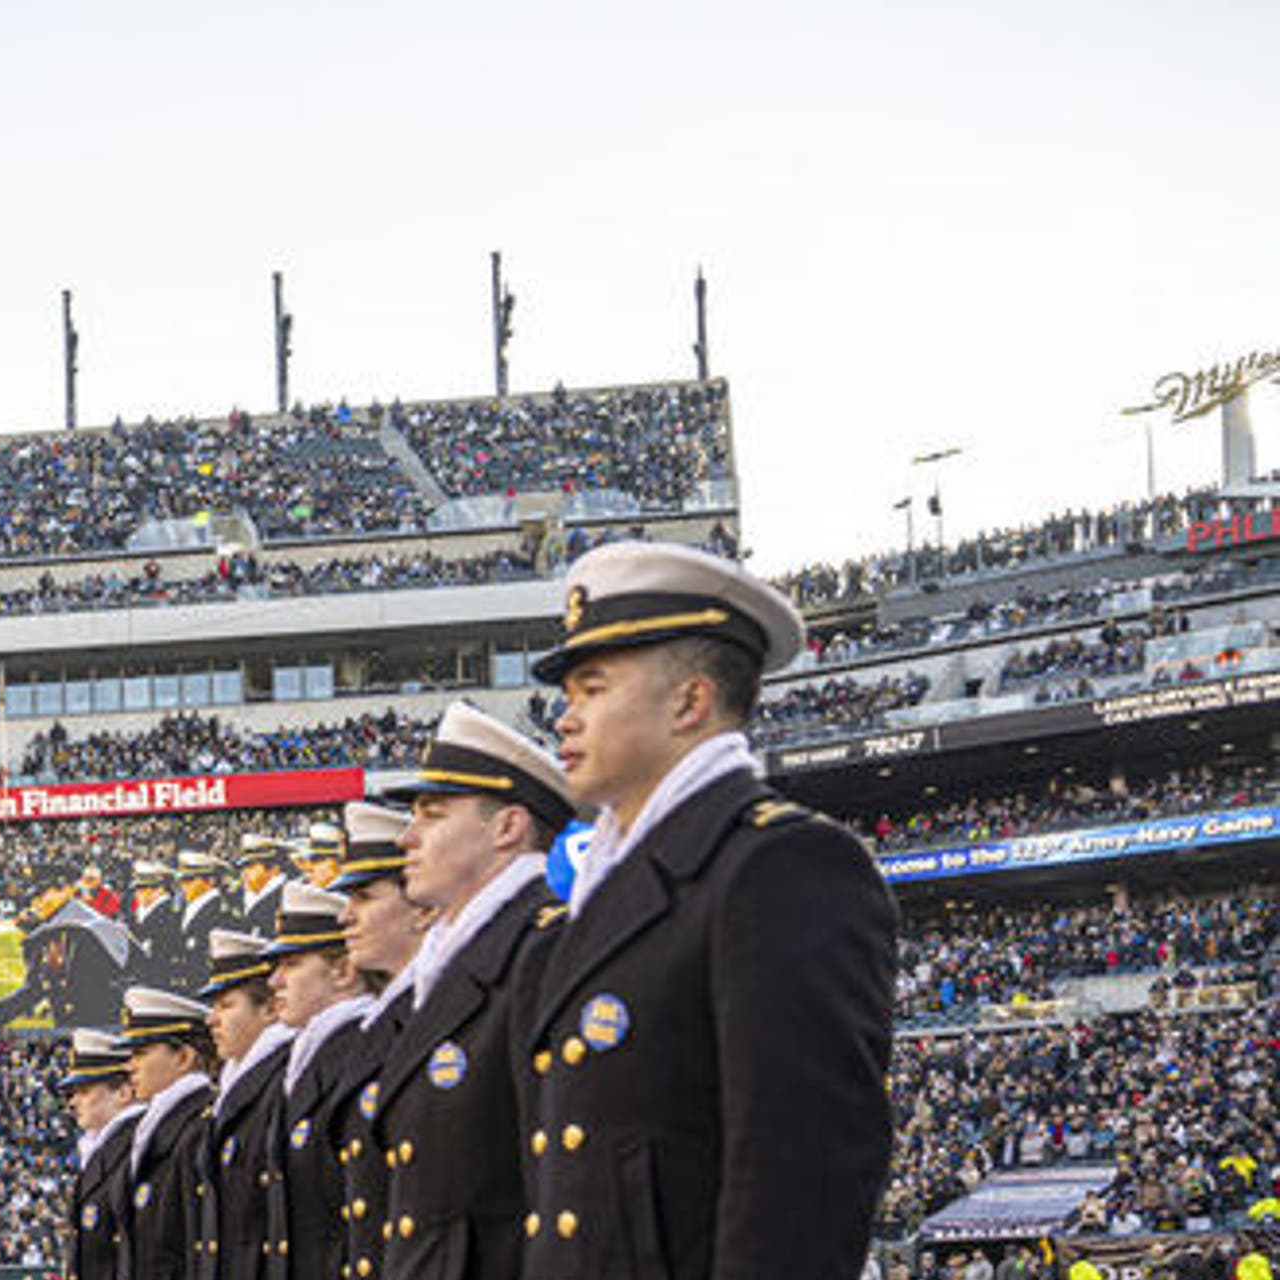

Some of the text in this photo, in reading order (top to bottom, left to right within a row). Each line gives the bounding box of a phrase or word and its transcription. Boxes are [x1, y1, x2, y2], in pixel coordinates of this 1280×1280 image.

[22, 784, 148, 817] Financial
[154, 778, 226, 809] Field
[1203, 814, 1274, 837] Game
